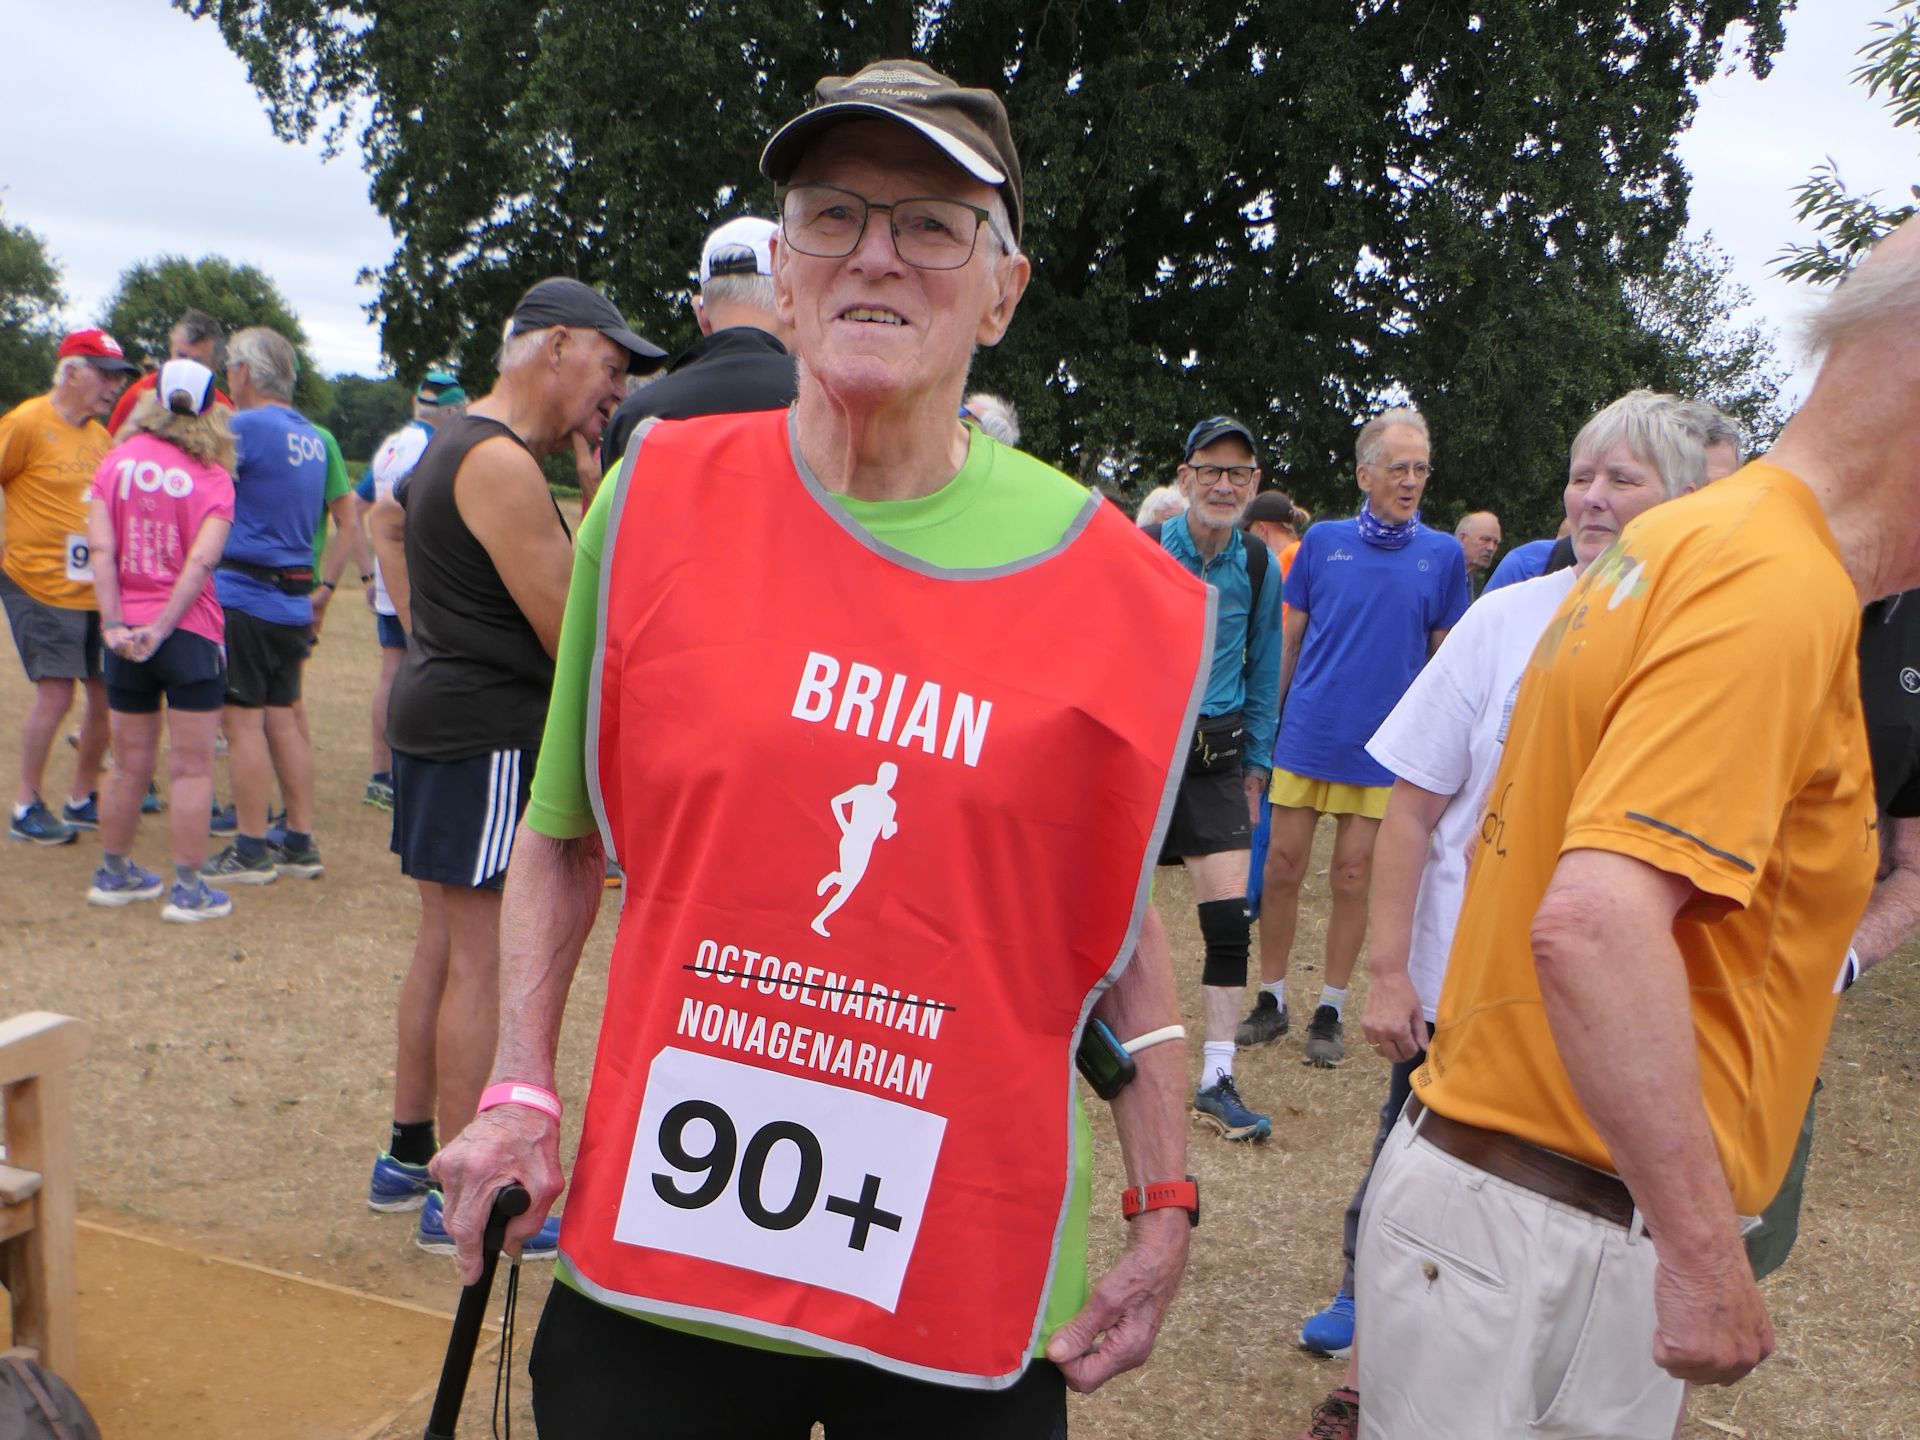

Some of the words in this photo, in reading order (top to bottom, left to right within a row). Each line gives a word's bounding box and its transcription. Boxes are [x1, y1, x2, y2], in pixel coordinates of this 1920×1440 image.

[116, 458, 194, 500] 100
[287, 432, 326, 467] 500
[791, 651, 992, 767] BRIAN
[695, 940, 945, 1040] OCTOGENARIAN
[677, 998, 932, 1099] NONAGENARIAN
[652, 1100, 902, 1251] 90+
